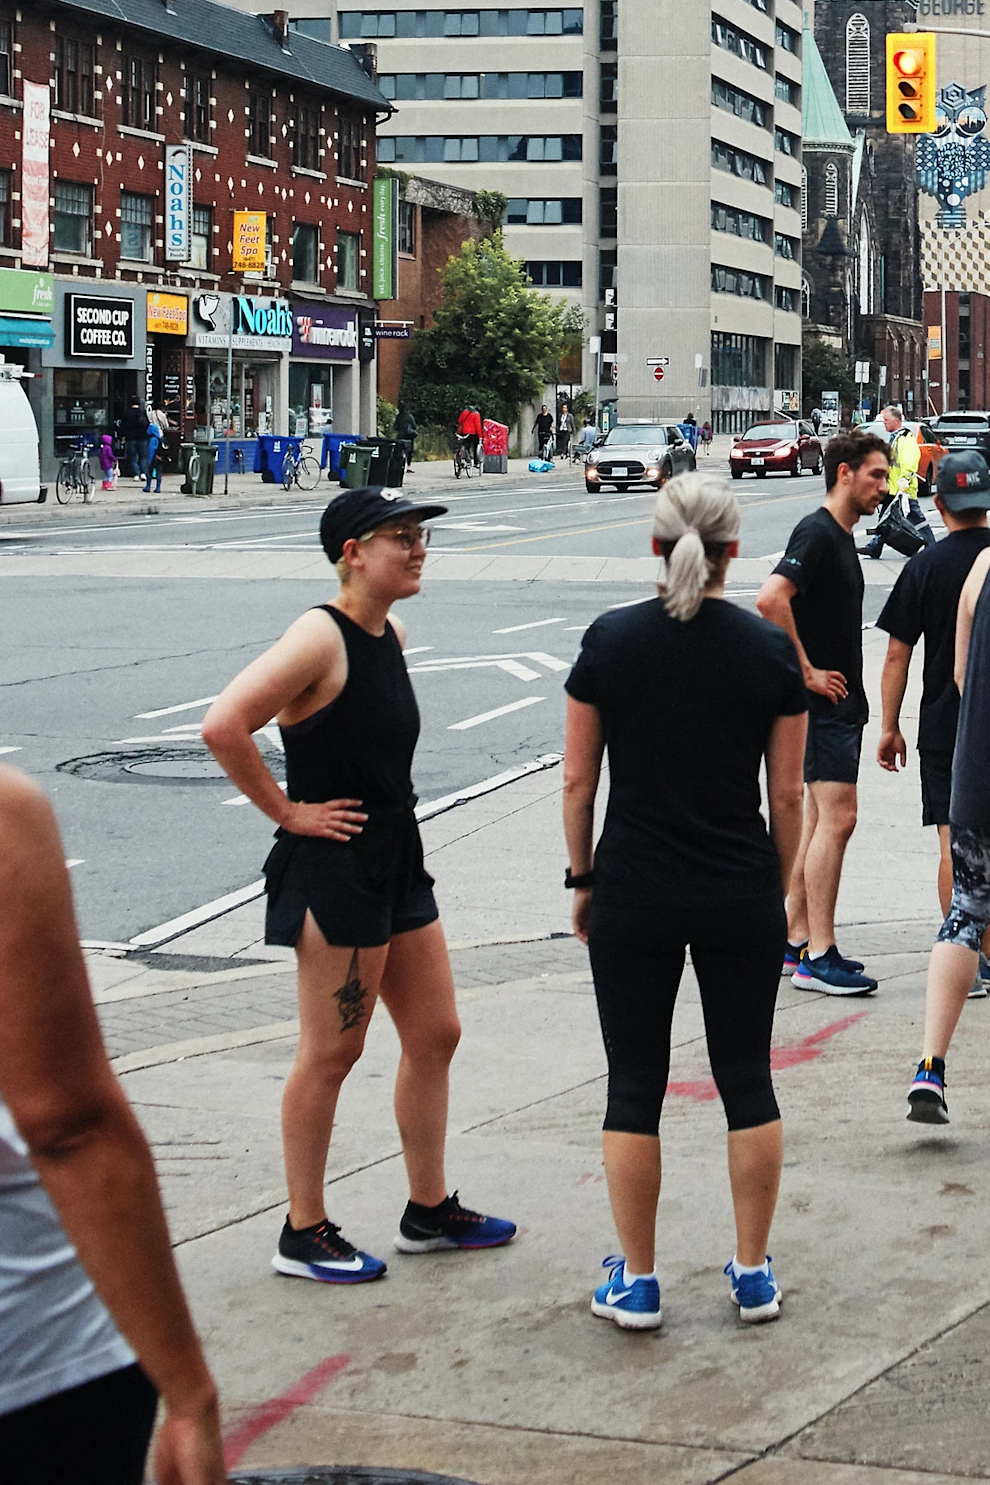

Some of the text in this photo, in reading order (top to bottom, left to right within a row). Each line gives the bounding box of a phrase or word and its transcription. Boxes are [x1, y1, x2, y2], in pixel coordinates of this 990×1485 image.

[29, 101, 45, 121] FOR
[25, 128, 49, 150] LEASE
[239, 223, 260, 232] New
[377, 213, 389, 242] fresh
[239, 234, 260, 244] Feet
[240, 245, 258, 256] Spa
[76, 306, 130, 326] SECOND CUP
[237, 296, 293, 336] Noah's
[80, 327, 127, 347] COFFEE CO.
[198, 335, 226, 346] VITAMINS
[375, 329, 409, 337] wine rack
